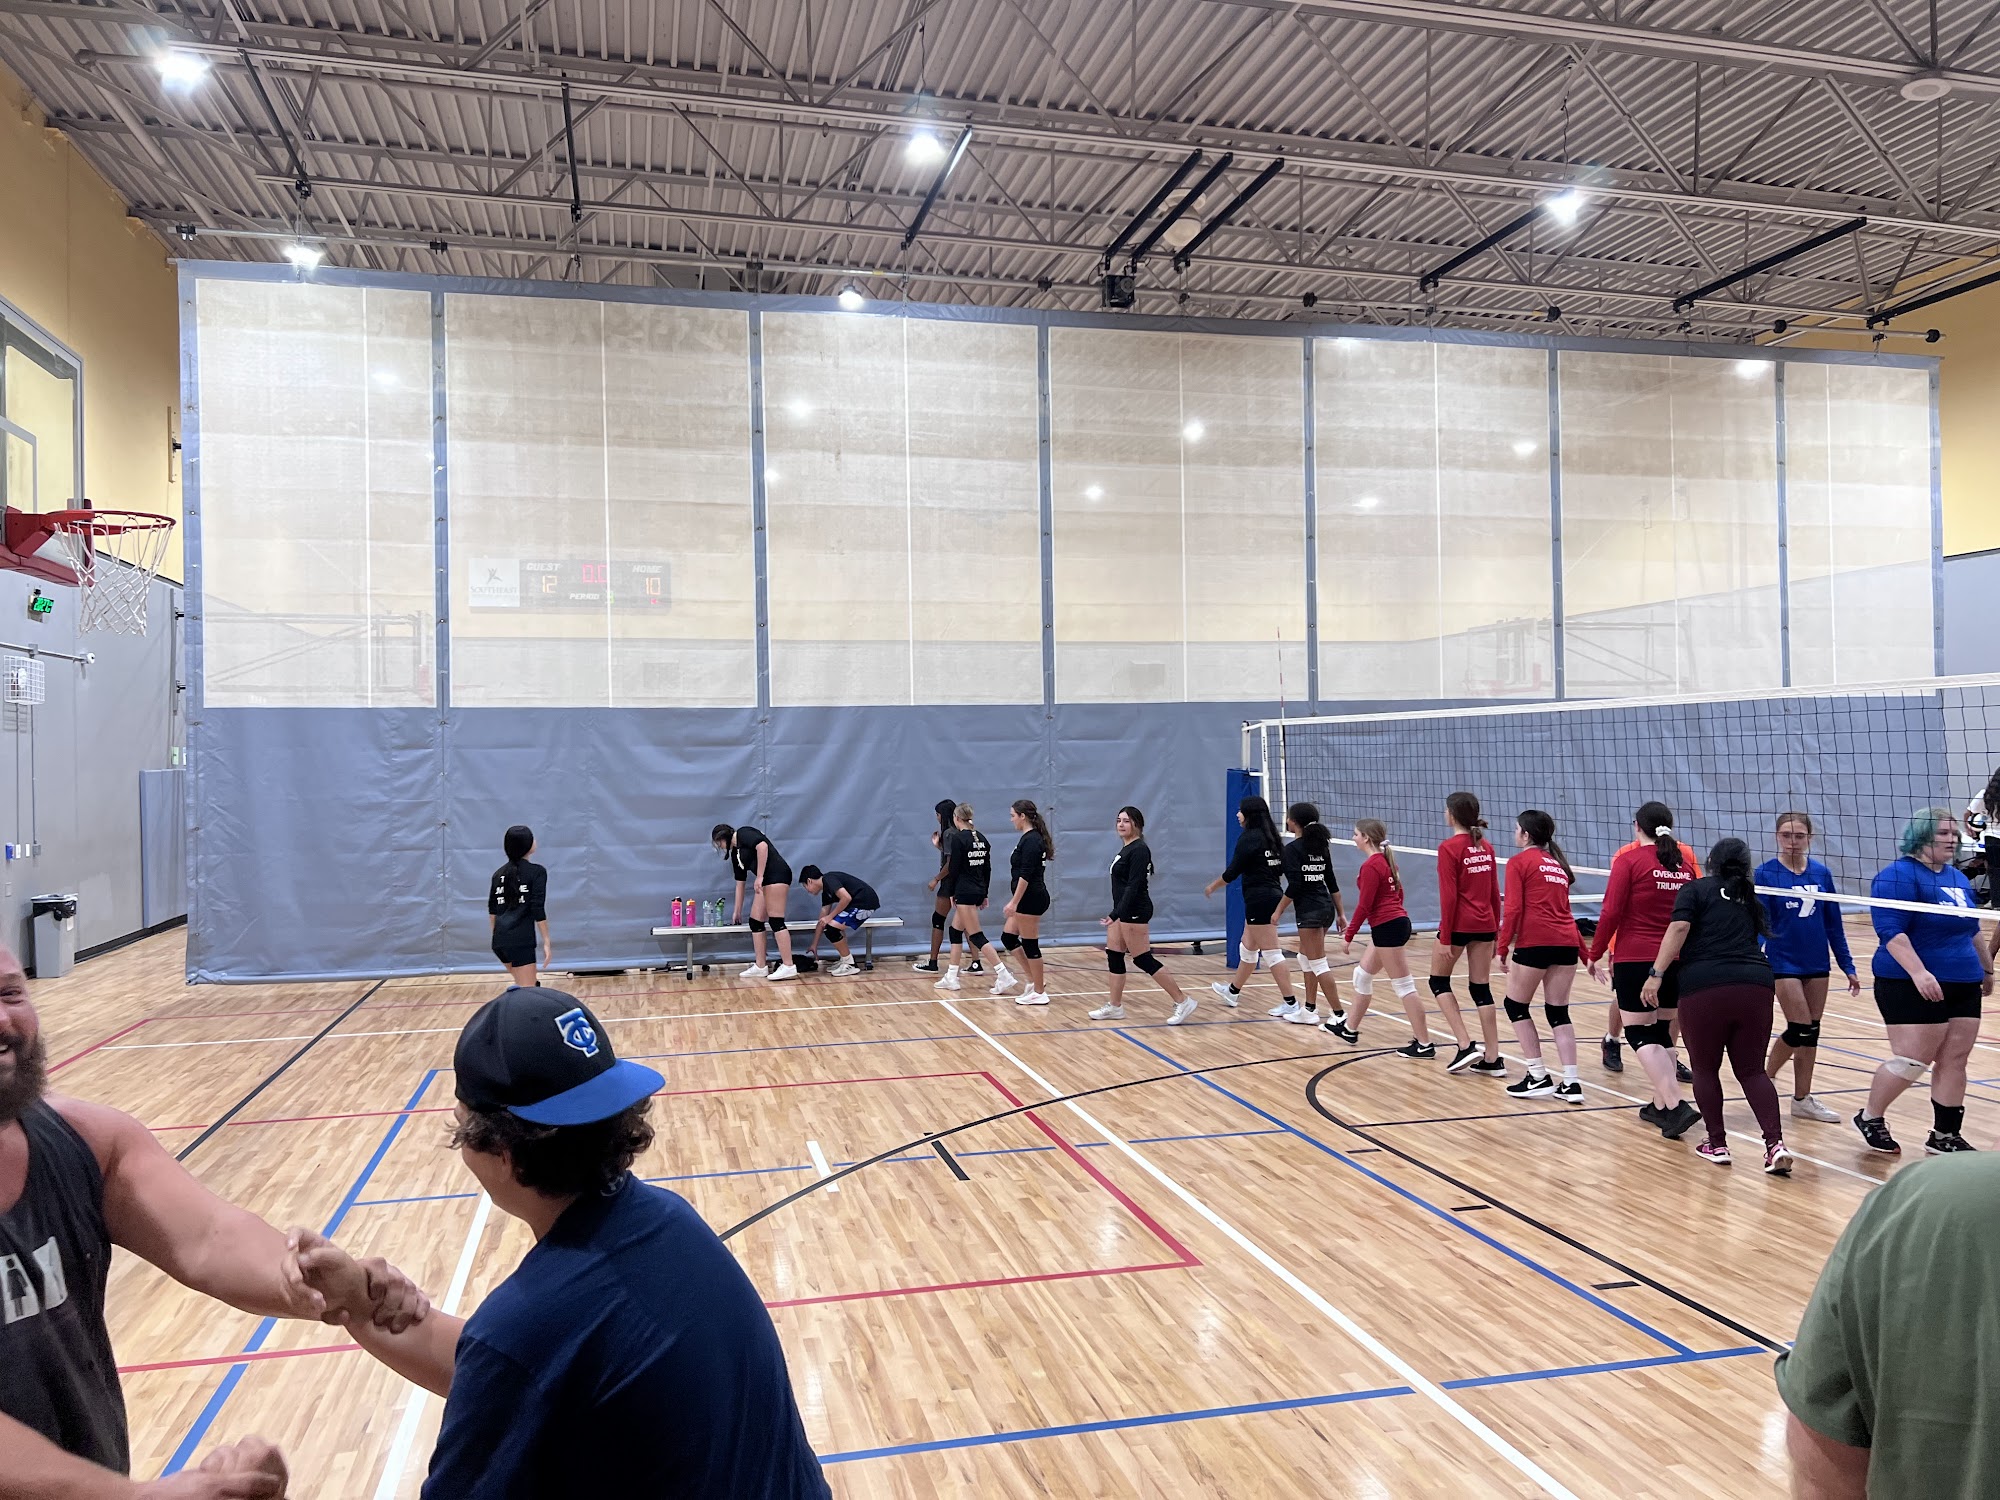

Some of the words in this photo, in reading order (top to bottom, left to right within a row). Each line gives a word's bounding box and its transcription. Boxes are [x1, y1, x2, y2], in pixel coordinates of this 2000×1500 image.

[526, 562, 561, 571] GUEST
[632, 565, 663, 574] HOME
[542, 575, 558, 593] 12
[645, 577, 661, 595] 10
[469, 585, 519, 594] SOUTHEAST
[569, 592, 600, 600] PERIOD
[1785, 900, 1800, 909] the
